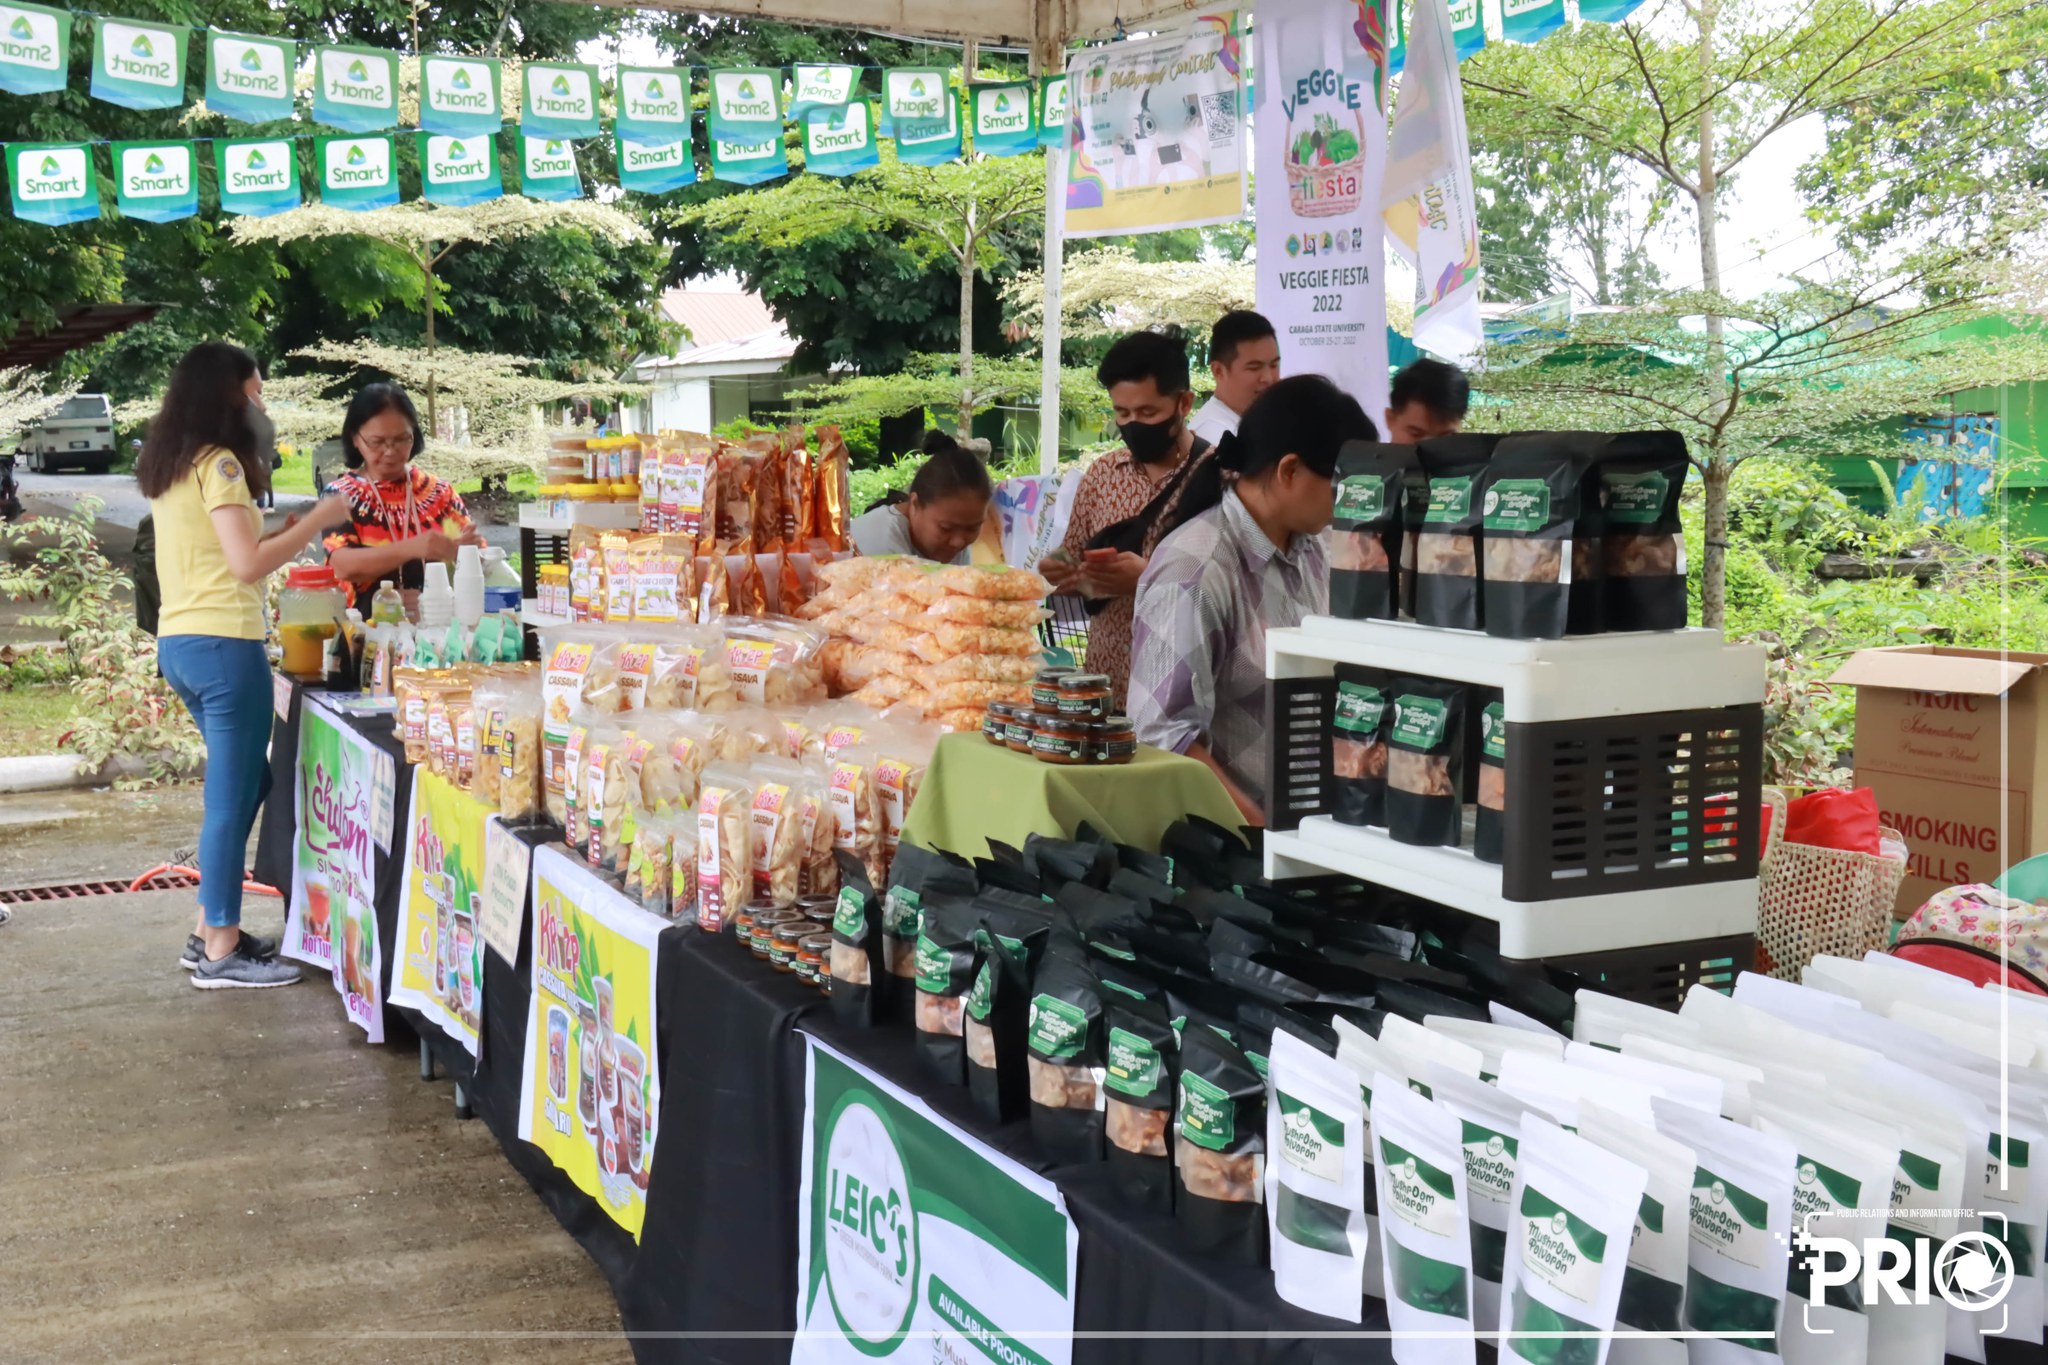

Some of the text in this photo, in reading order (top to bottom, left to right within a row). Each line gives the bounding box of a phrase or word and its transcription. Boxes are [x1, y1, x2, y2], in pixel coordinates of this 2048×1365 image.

[1450, 5, 1473, 24] art
[1281, 68, 1361, 122] VEGGIE
[906, 120, 952, 138] Smart
[983, 112, 1025, 129] Smart
[815, 128, 862, 149] Smart
[629, 146, 678, 165] Smart
[332, 165, 383, 182] Smart
[434, 159, 485, 177] Smart
[532, 158, 571, 172] Smar
[26, 176, 80, 194] Smart
[130, 174, 184, 191] Smart
[232, 169, 285, 187] Smart
[1300, 174, 1356, 199] fiesta
[1279, 266, 1369, 289] VEGGIE FIESTA
[1312, 294, 1343, 312] 2022
[1289, 323, 1365, 334] CARAGA STATE UNIVERSITY
[1299, 337, 1325, 346] OCTOBER
[548, 675, 578, 688] CASSAVA
[620, 677, 643, 688] SSAVA
[1901, 712, 1981, 741] International
[1947, 747, 1979, 763] Blend
[1879, 811, 1997, 852] SMOKING
[829, 1168, 907, 1277] LEIC'S
[1690, 1208, 1734, 1243] Polvoron
[1529, 1238, 1568, 1275] Polvoron
[939, 1293, 1038, 1365] AVAILABLE PRODU
